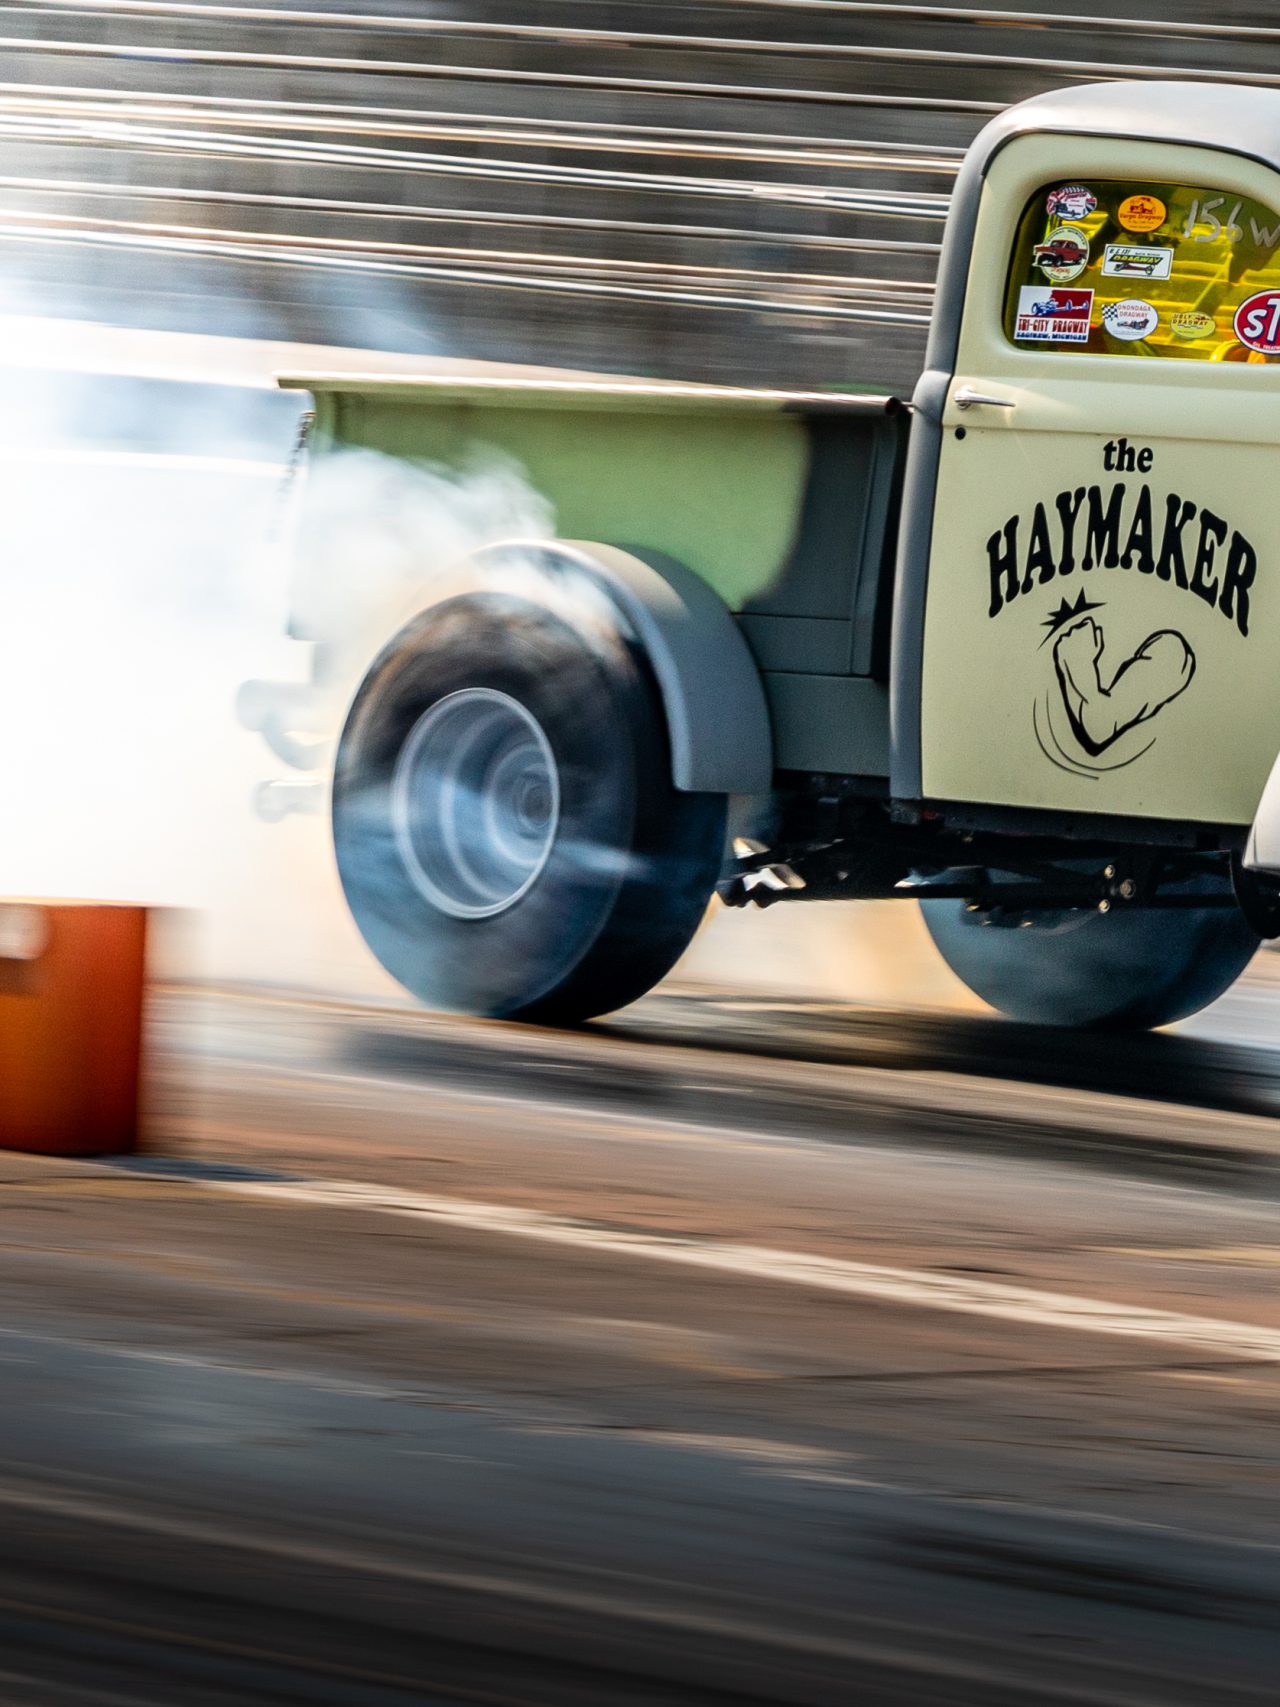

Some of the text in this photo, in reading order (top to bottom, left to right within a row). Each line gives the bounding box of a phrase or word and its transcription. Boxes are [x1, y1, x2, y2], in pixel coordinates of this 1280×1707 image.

[1112, 255, 1161, 264] DRAGWAY
[1117, 304, 1151, 312] ONONDAGA
[1018, 318, 1088, 333] TRI-CITY DRAGWAY
[1103, 438, 1154, 473] the
[986, 482, 1257, 638] HAYMAKER
